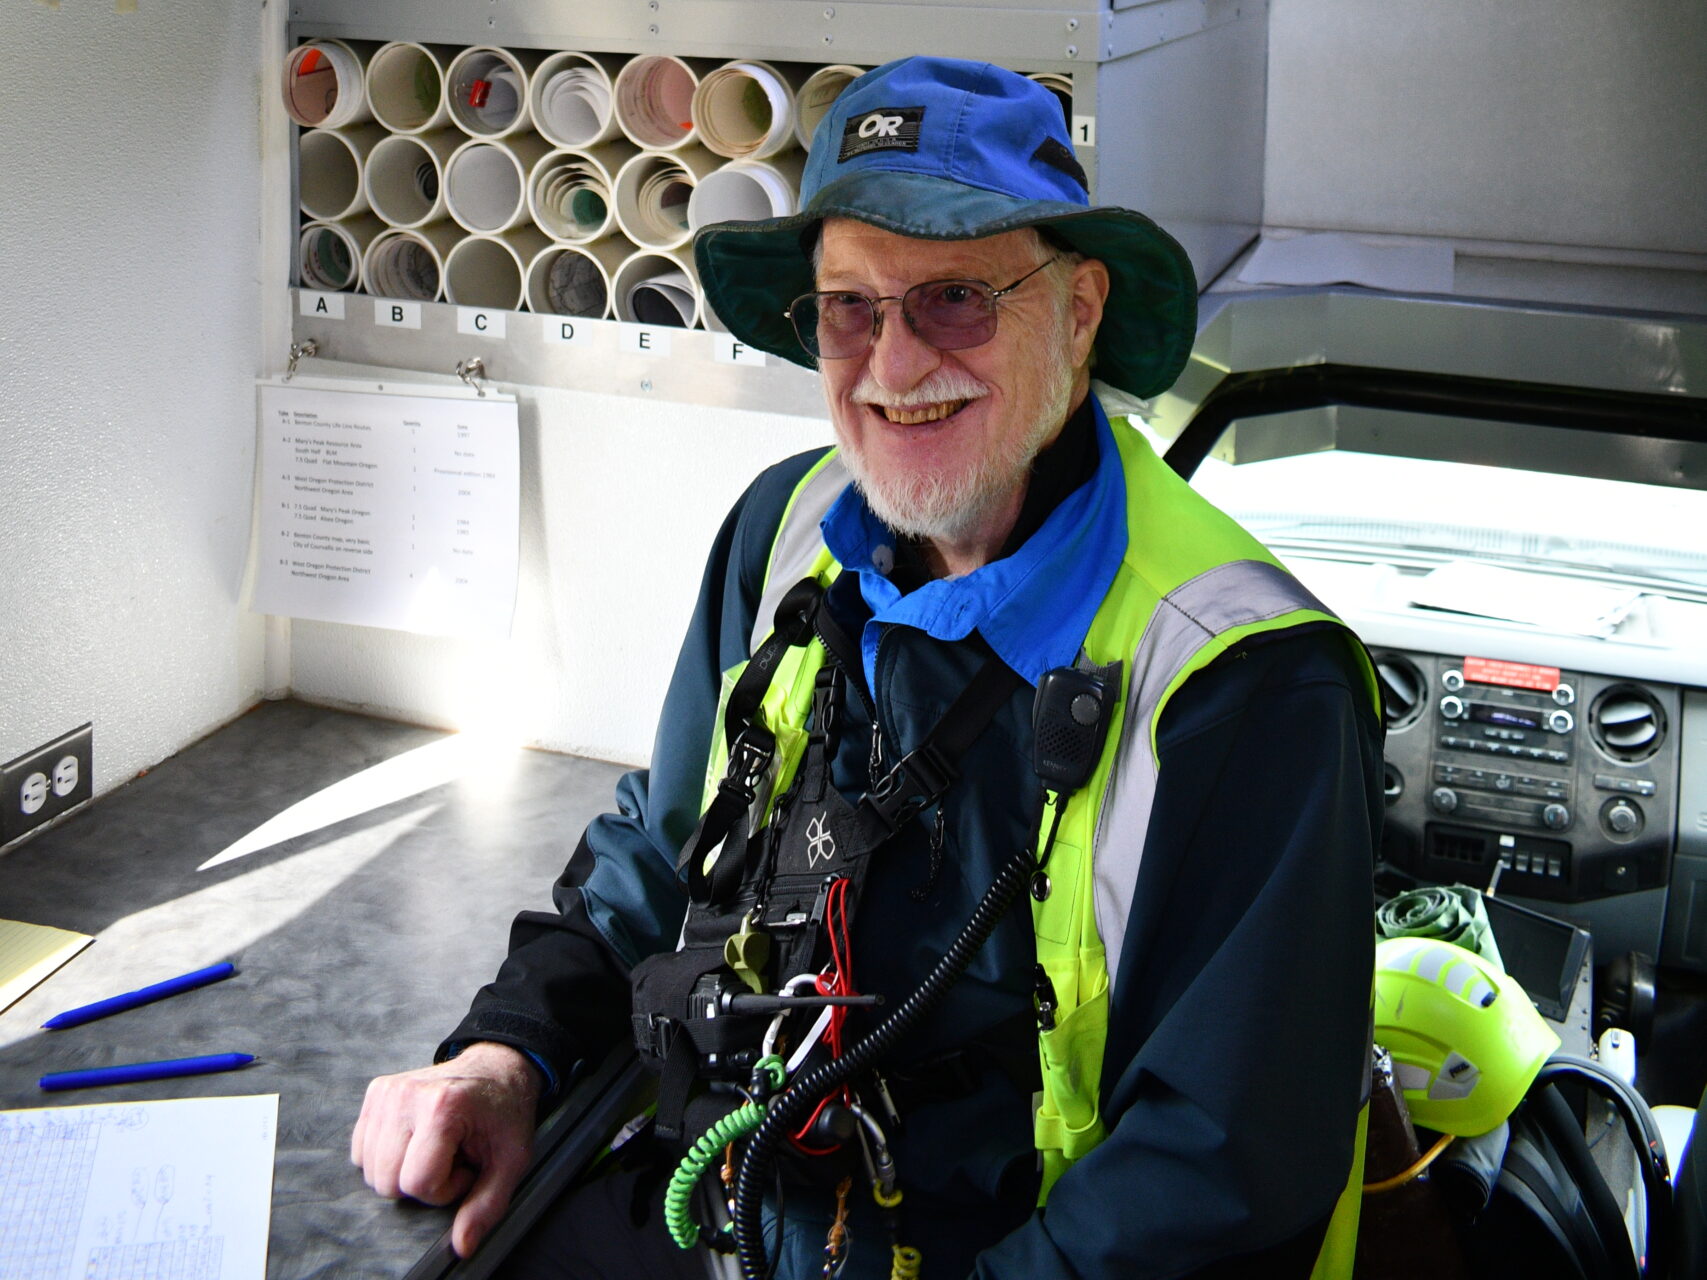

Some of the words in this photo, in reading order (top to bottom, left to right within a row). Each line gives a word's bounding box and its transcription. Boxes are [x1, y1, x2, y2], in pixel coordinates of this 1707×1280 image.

[859, 114, 904, 139] OR
[1079, 123, 1089, 142] 1
[315, 298, 329, 314] A
[391, 306, 404, 323] B
[474, 315, 488, 332] C
[560, 323, 574, 341] D
[639, 332, 651, 349] E
[732, 343, 743, 360] F
